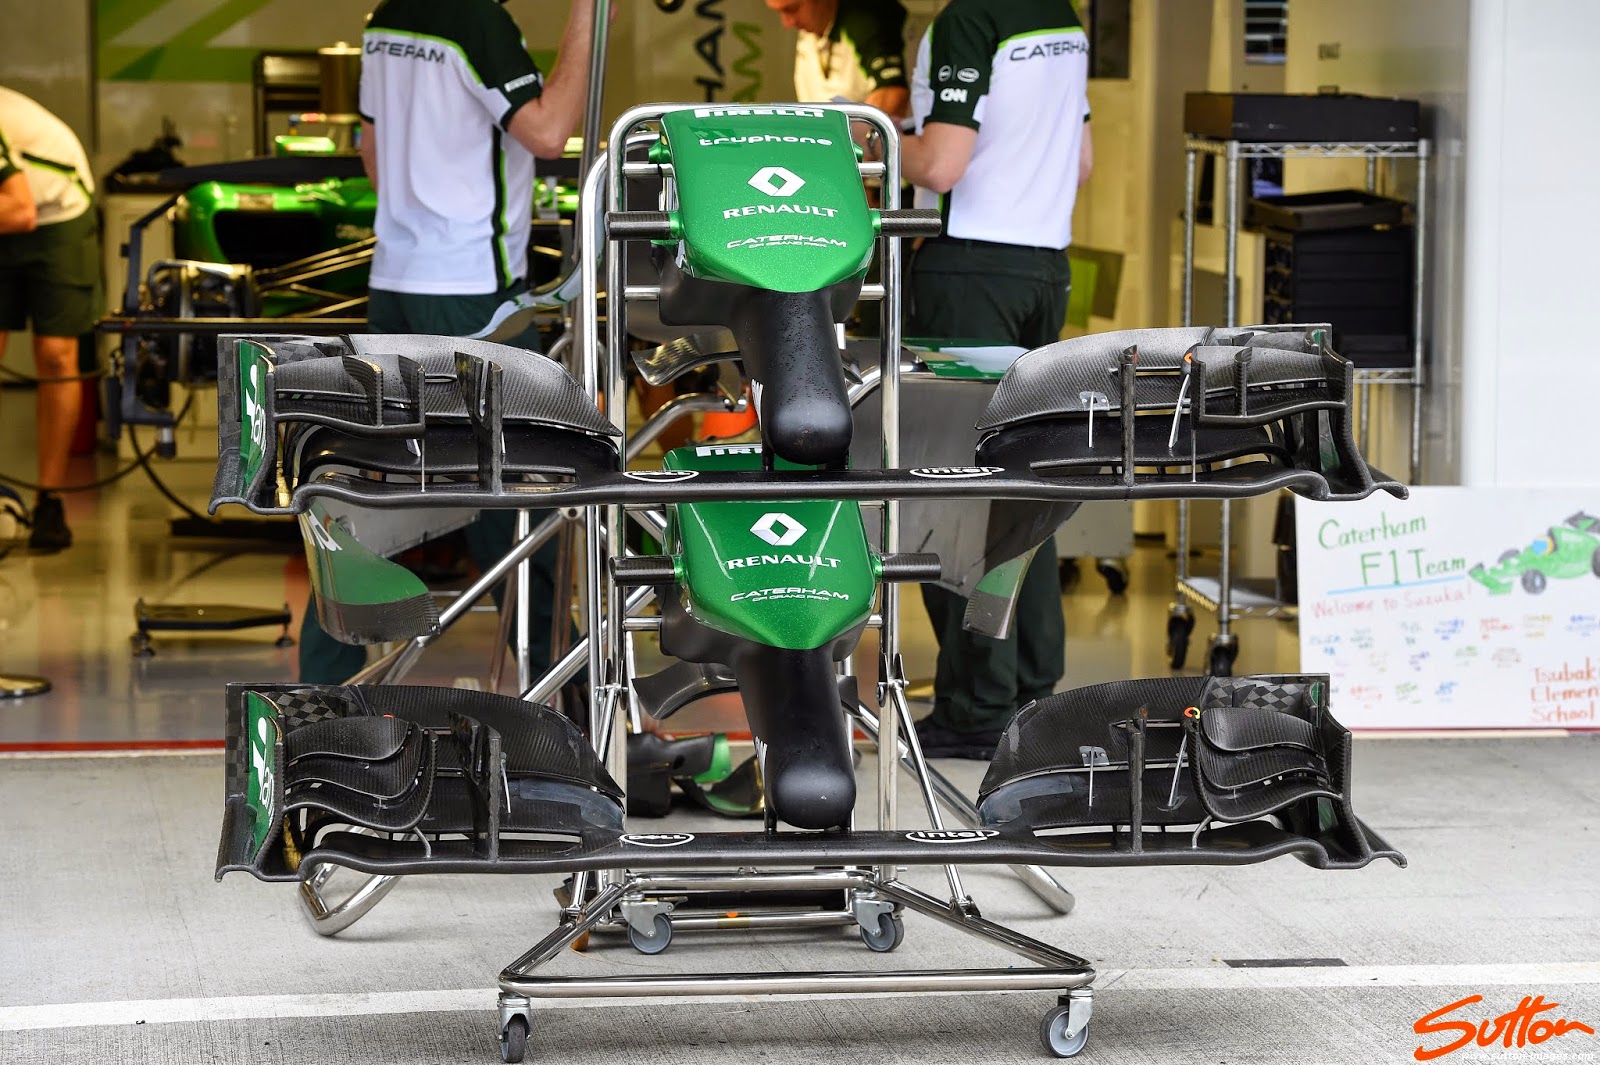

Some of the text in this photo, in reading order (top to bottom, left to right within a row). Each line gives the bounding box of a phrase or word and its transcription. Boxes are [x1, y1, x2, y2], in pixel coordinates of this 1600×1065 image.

[699, 134, 833, 146] truphone
[722, 204, 838, 220] RENAULT
[726, 234, 847, 249] CATERHAM
[1317, 511, 1427, 549] Caterham
[727, 554, 842, 570] RENAULT
[730, 587, 849, 602] CATERHAM
[1312, 599, 1374, 618] Welcome
[1383, 597, 1398, 610] to
[1530, 685, 1600, 703] Elemen
[1529, 700, 1595, 723] School
